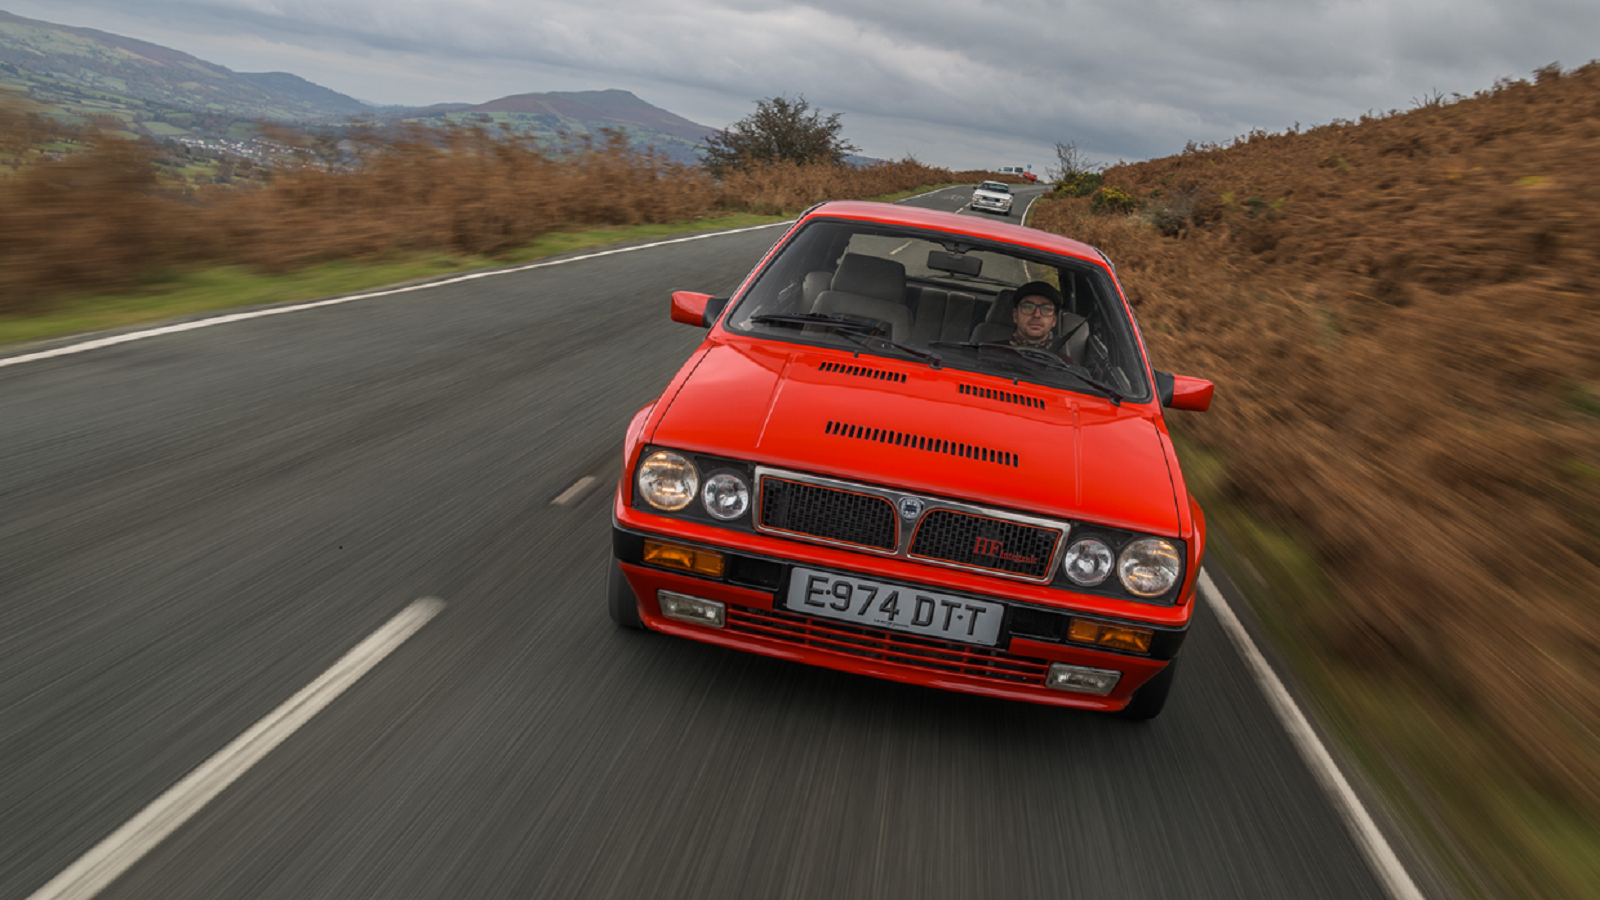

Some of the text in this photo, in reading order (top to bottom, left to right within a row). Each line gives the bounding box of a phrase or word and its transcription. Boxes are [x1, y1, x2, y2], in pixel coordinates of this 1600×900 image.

[973, 536, 1003, 557] HF
[804, 575, 987, 636] E974 DTT
